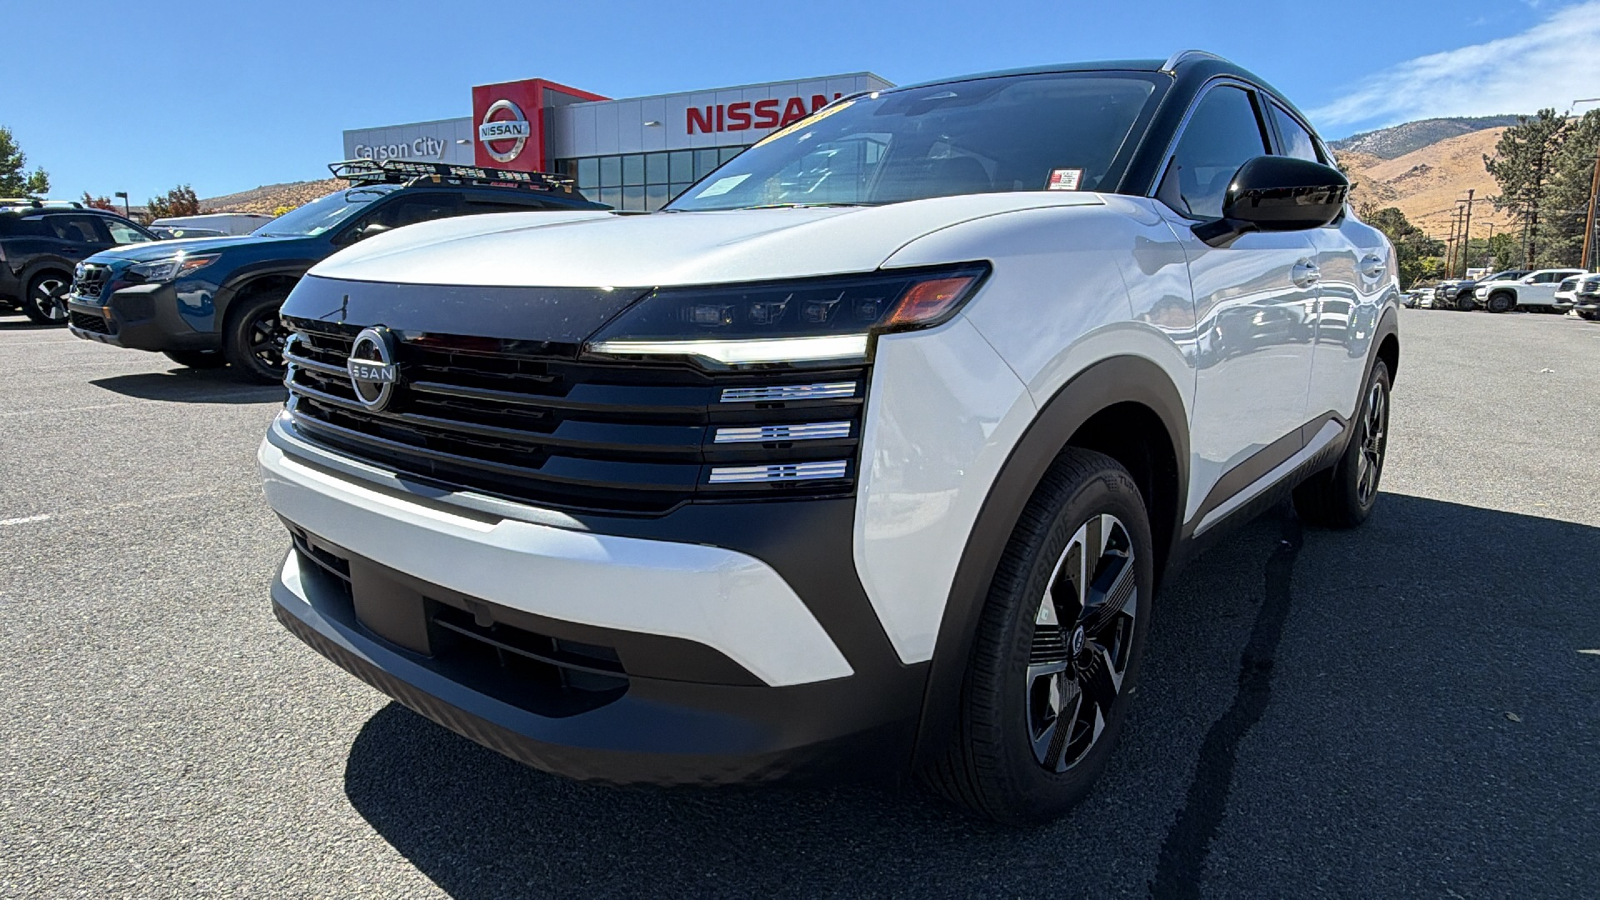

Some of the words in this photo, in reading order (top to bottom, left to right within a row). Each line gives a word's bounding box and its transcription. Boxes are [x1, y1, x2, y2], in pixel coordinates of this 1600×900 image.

[481, 124, 522, 137] NISSAN
[354, 143, 409, 160] Carson
[413, 137, 445, 159] City
[350, 364, 394, 380] SSAN
